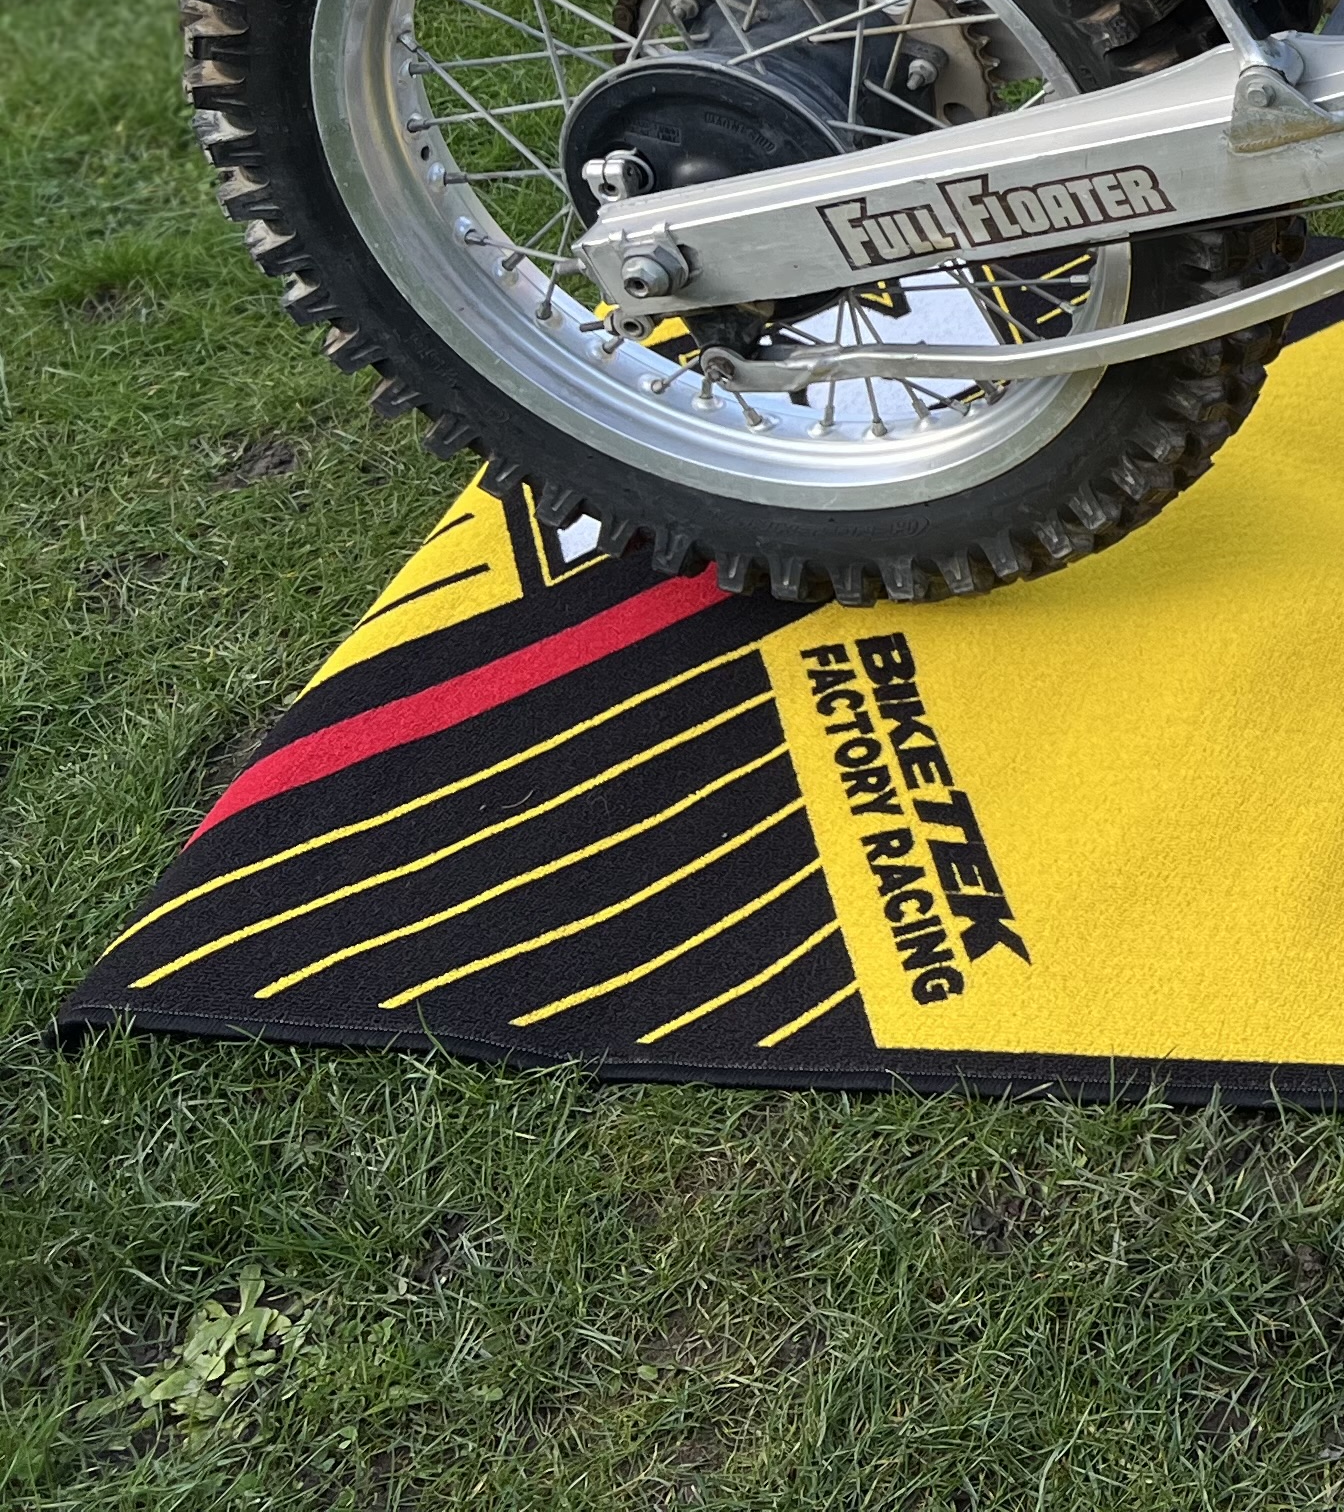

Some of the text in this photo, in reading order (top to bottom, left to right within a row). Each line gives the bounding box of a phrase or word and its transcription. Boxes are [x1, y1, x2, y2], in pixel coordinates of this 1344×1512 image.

[820, 167, 1170, 269] FULL FLOATER
[801, 643, 905, 816] FACTORY
[861, 827, 966, 1006] RACING
